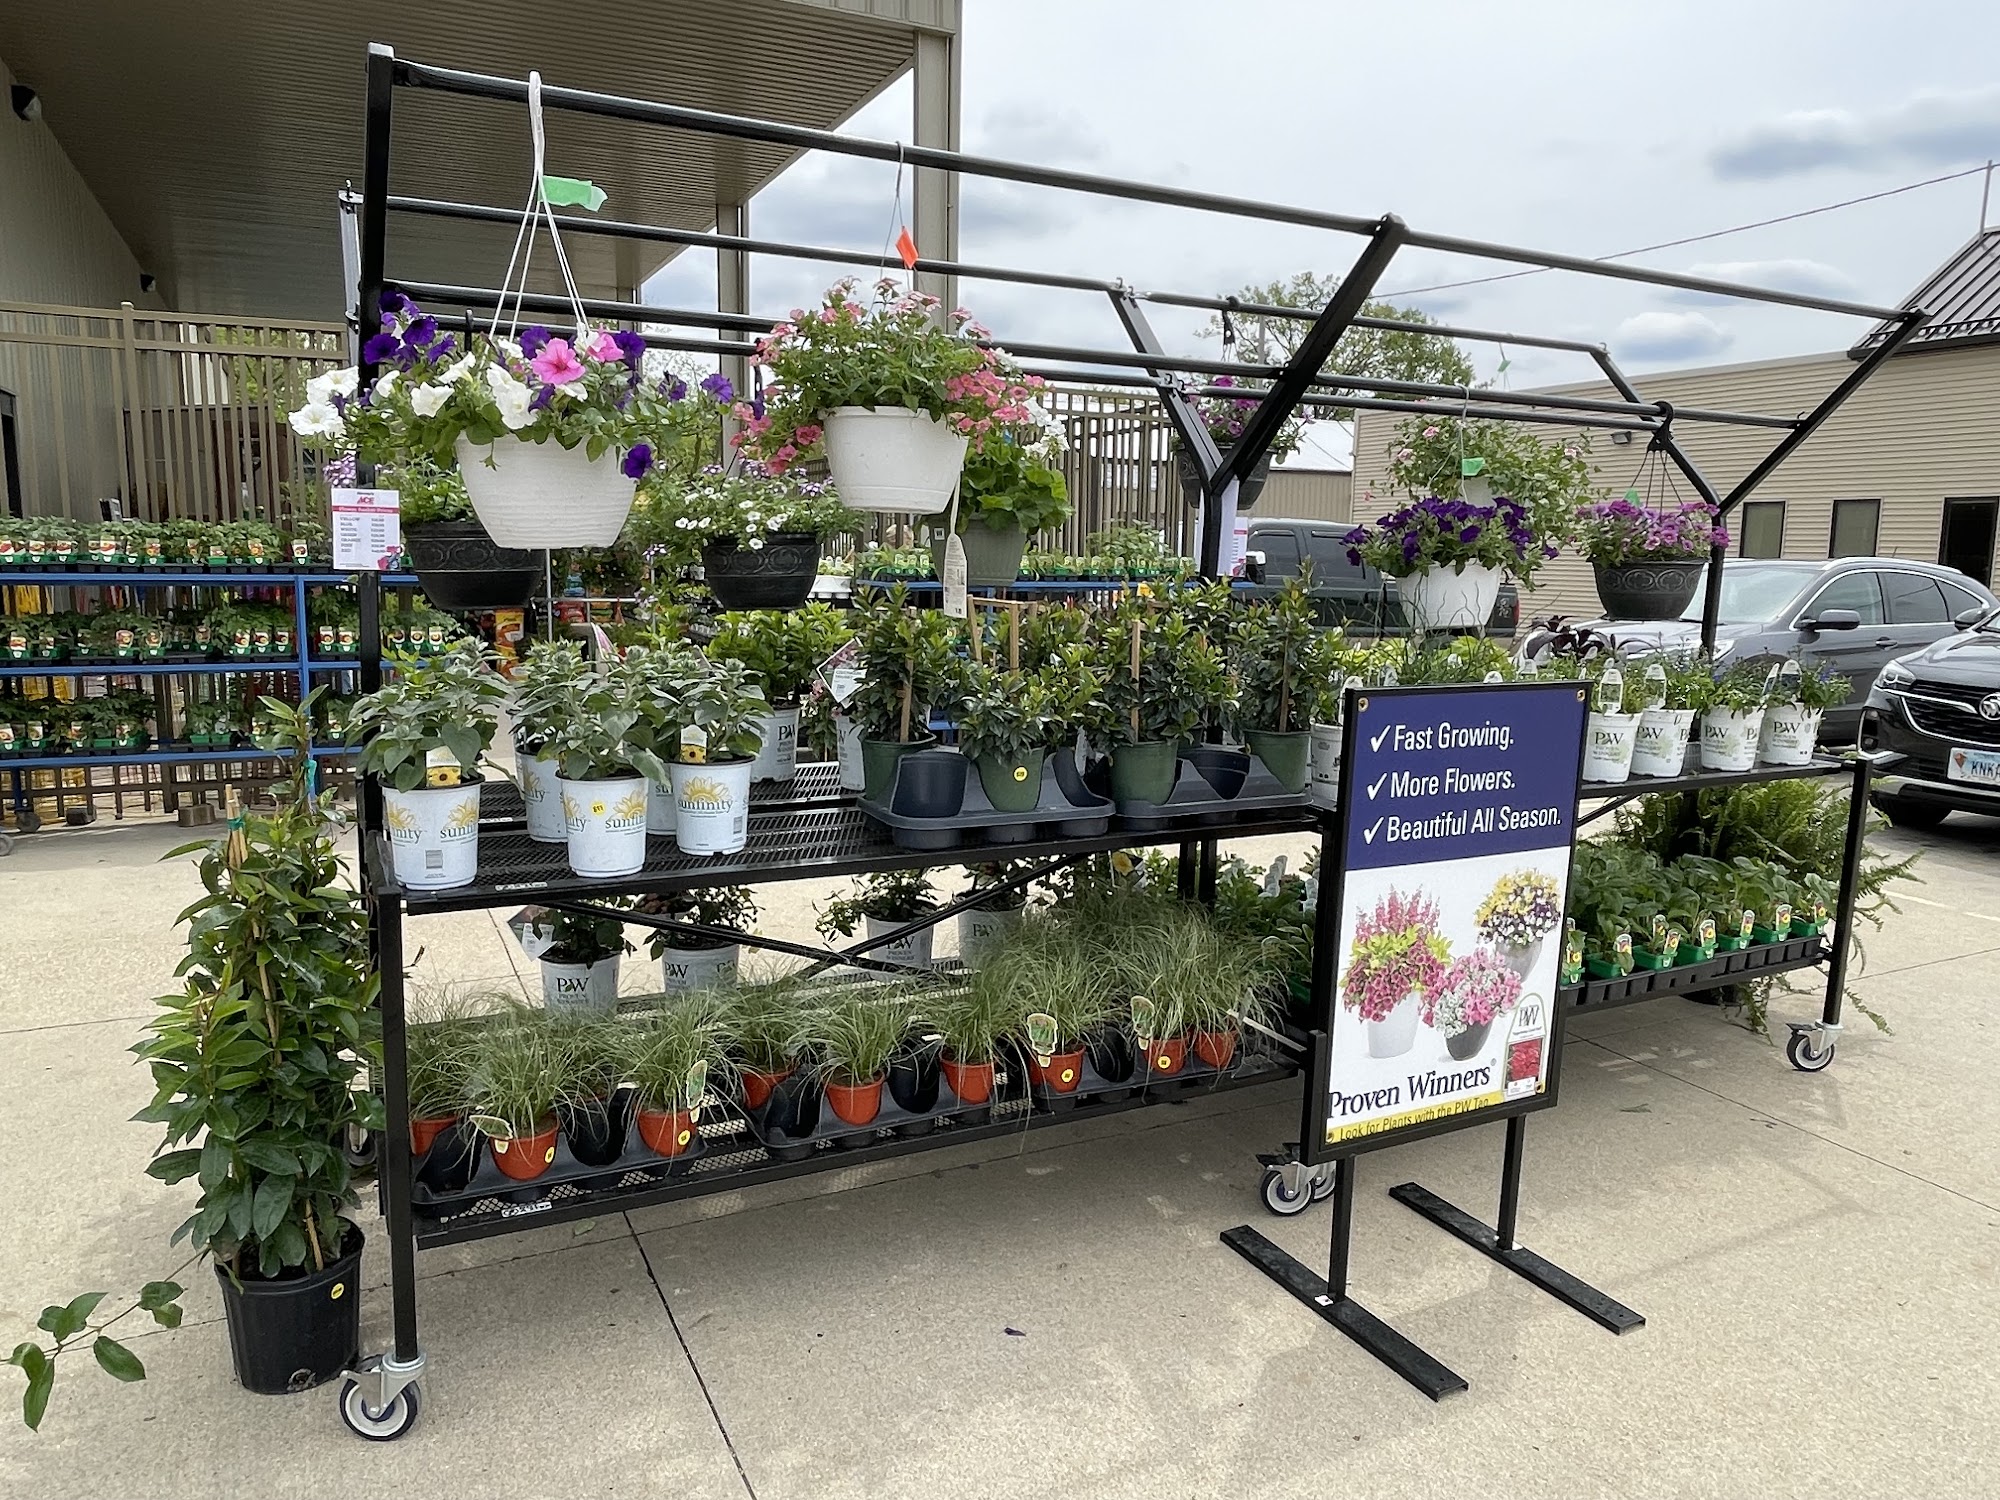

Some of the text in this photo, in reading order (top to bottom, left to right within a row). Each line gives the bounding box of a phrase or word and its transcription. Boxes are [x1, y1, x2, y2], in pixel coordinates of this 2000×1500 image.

[1393, 720, 1514, 752] Fast Growing.
[1390, 767, 1516, 798] More Flowers.
[678, 797, 733, 813] sunfinity
[1386, 805, 1561, 842] Beautiful All Season.
[556, 976, 591, 992] PW
[1328, 1065, 1491, 1119] Proven Winners
[1340, 1126, 1364, 1140] Look
[1366, 1121, 1380, 1134] for
[1382, 1115, 1412, 1130] Plants
[1414, 1109, 1435, 1123] with
[1437, 1105, 1452, 1117] the
[1455, 1100, 1472, 1114] PW
